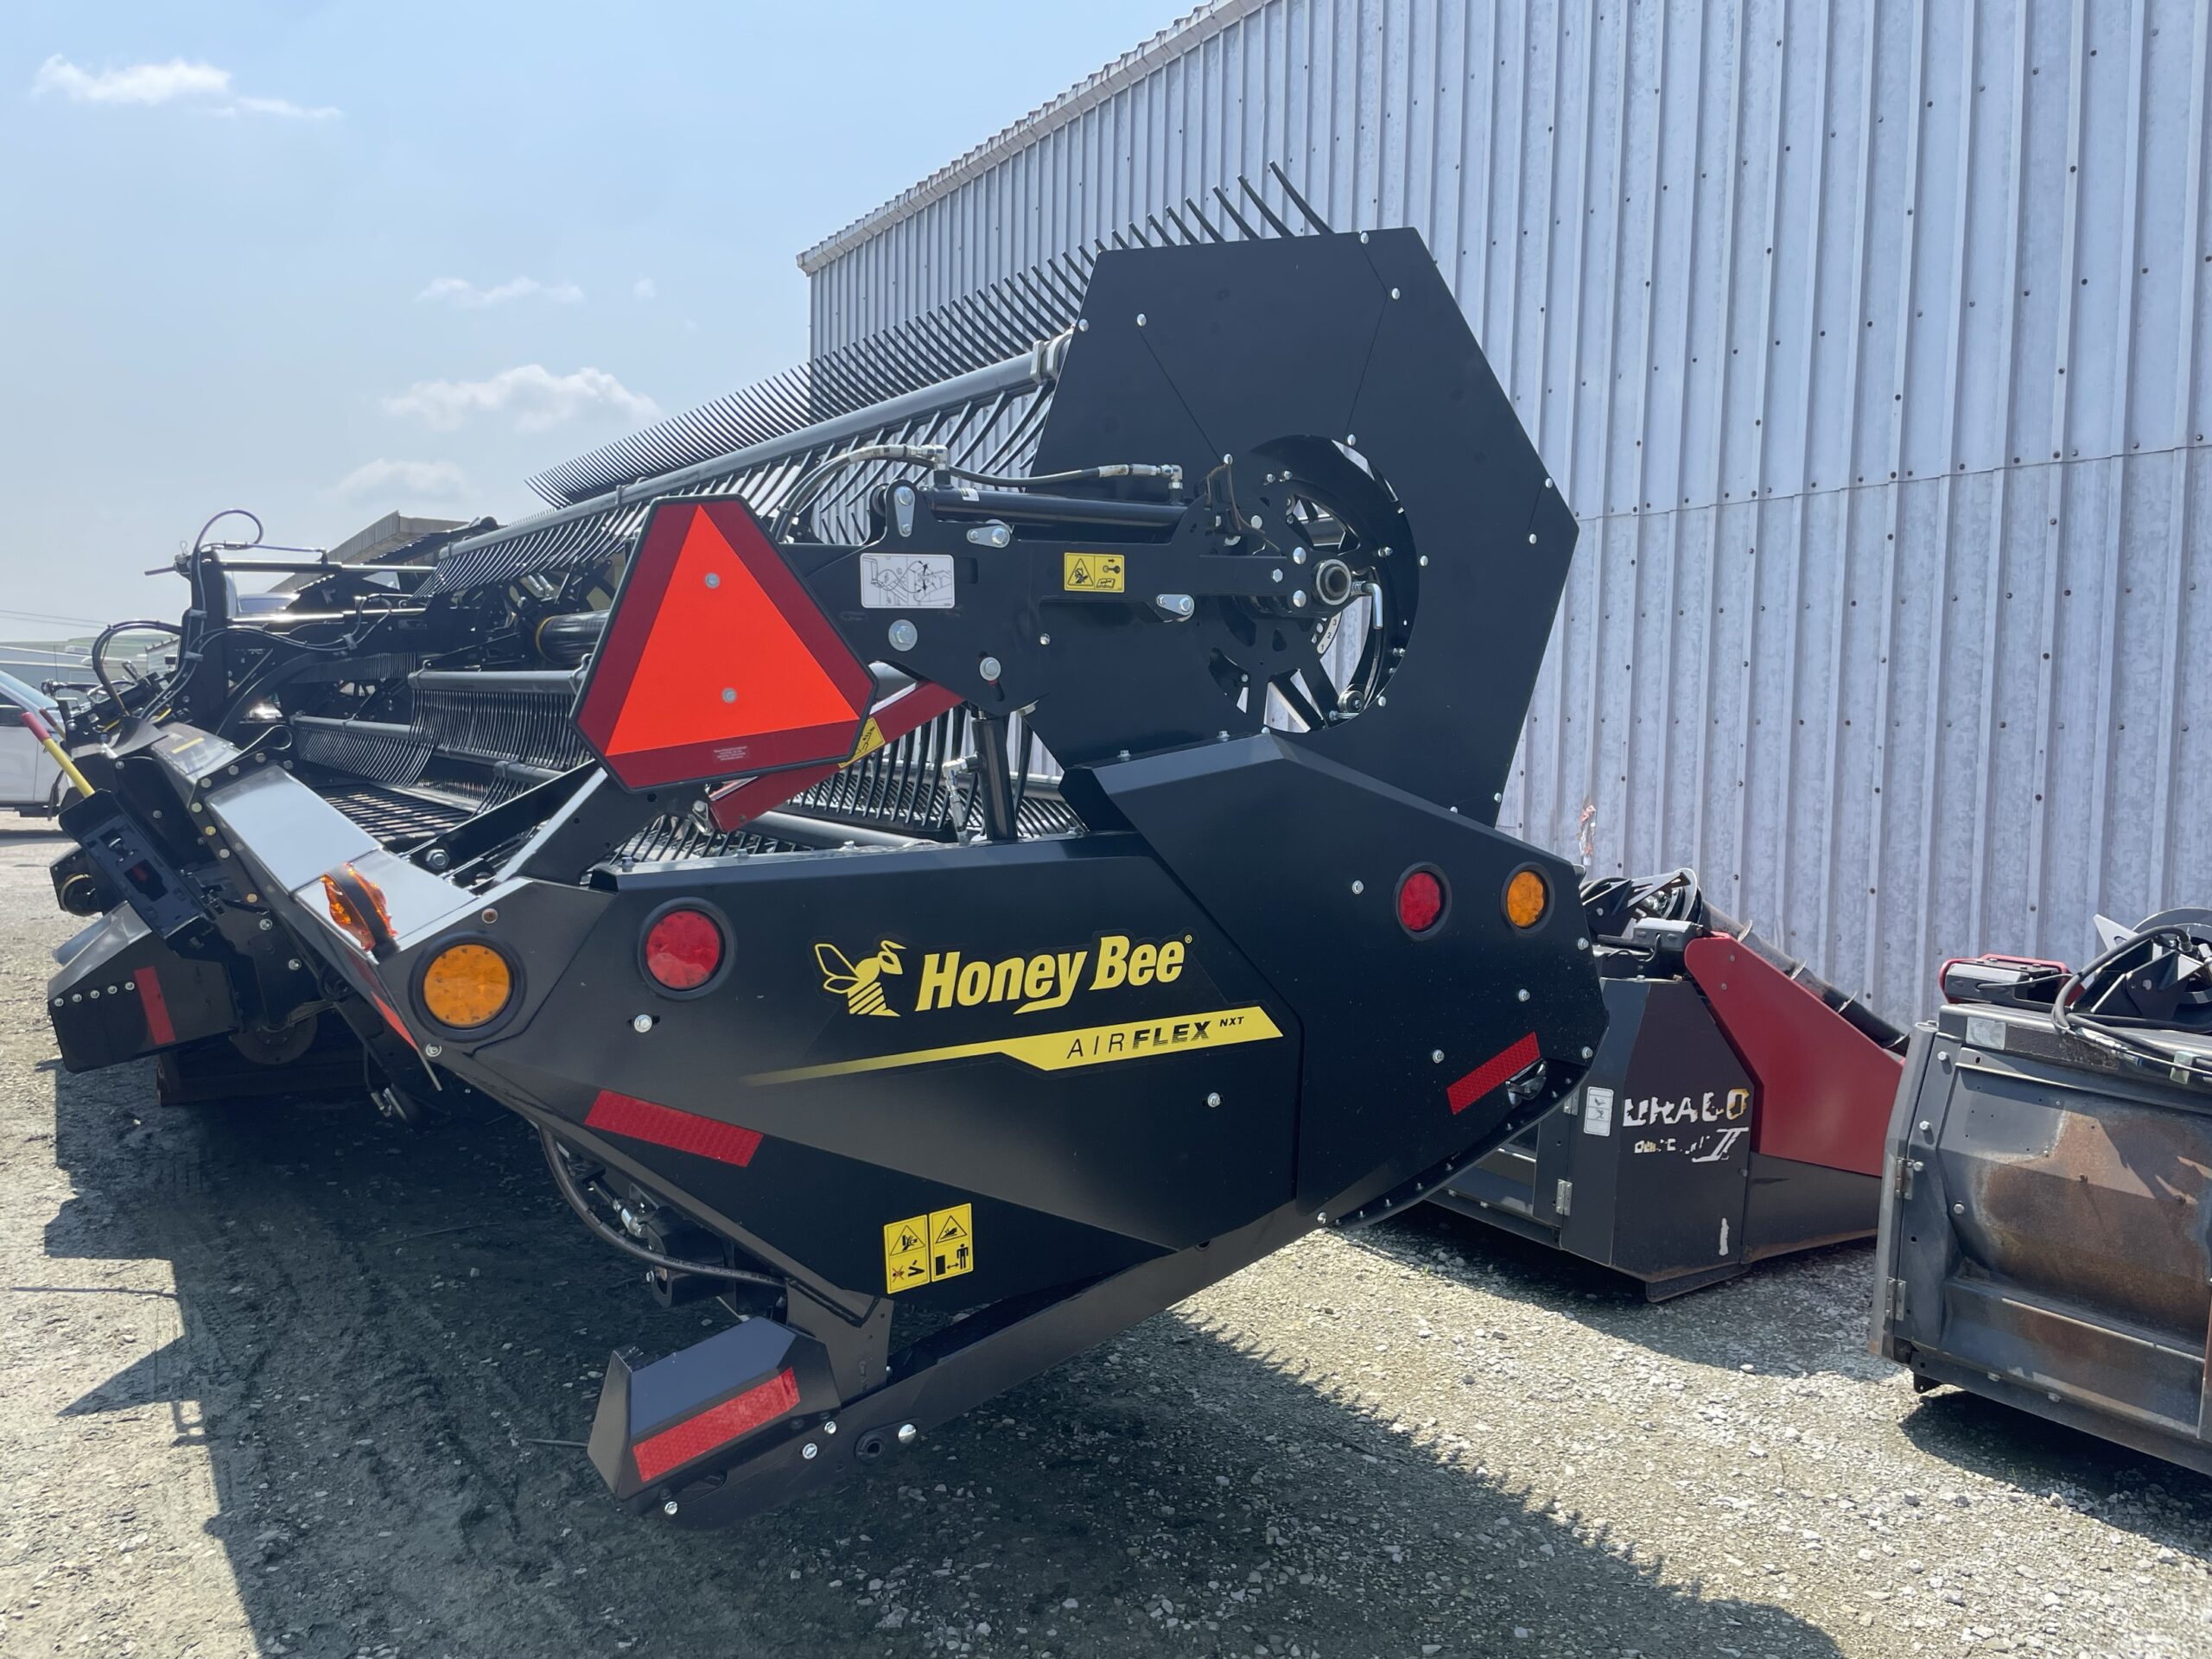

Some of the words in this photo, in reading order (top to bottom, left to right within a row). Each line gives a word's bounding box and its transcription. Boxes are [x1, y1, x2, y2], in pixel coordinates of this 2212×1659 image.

[915, 950, 1086, 1015] Honey
[1090, 935, 1185, 991] Bee
[1066, 1020, 1211, 1059] AIRFLEX
[1219, 1016, 1245, 1027] NXT
